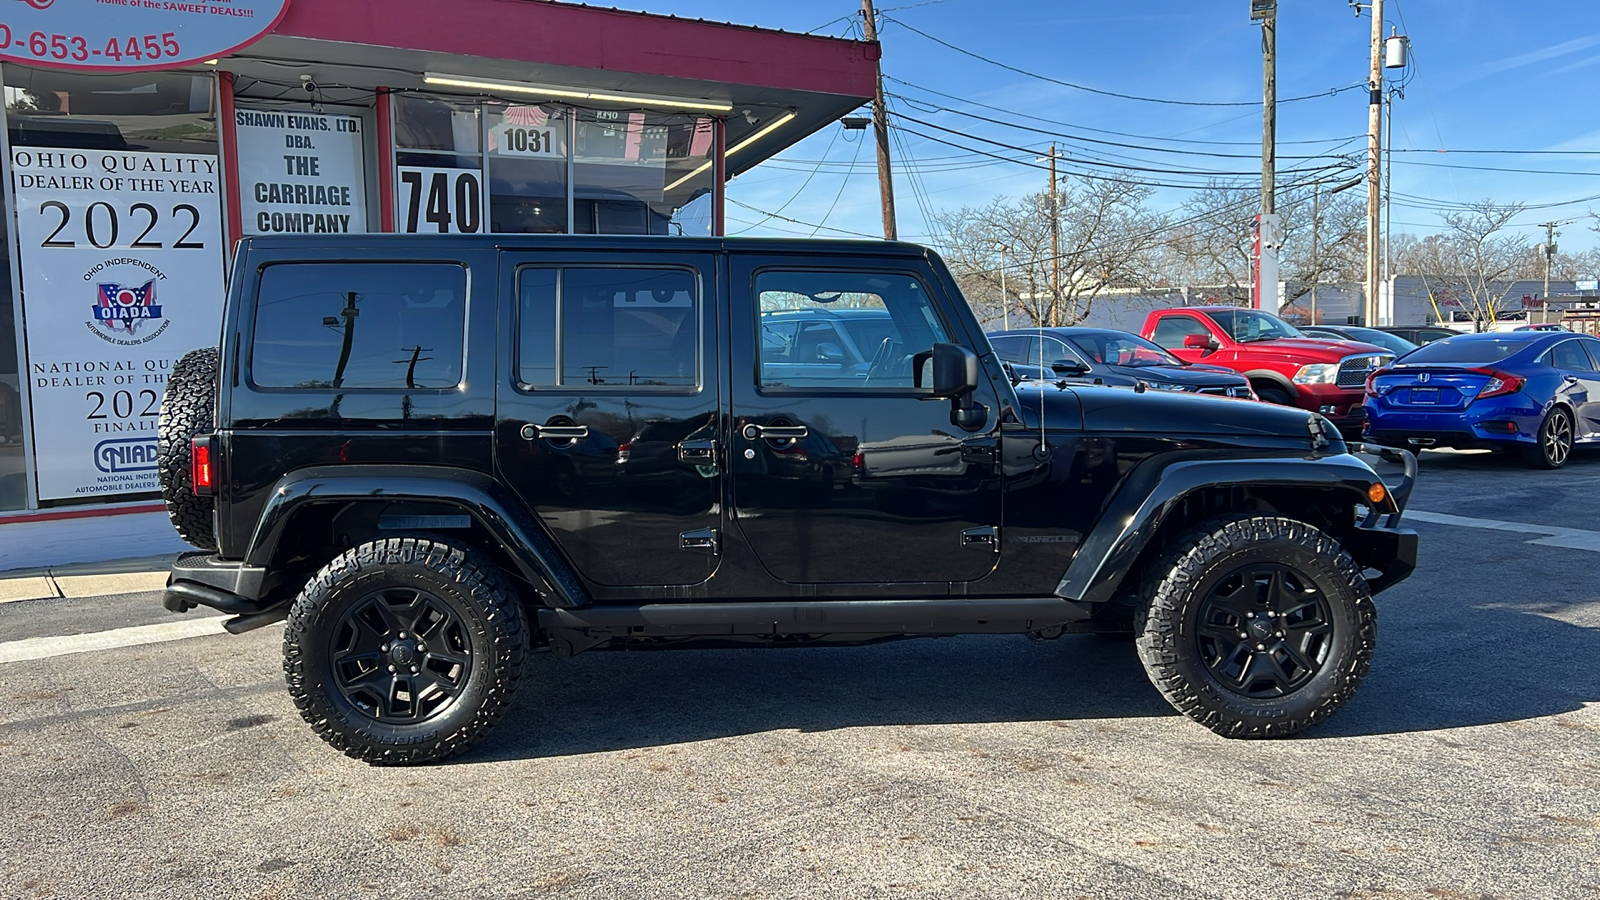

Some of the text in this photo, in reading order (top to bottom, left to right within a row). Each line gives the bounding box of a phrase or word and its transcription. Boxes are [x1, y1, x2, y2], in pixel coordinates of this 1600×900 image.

[143, 0, 161, 9] the
[163, 2, 208, 14] SAWEET
[210, 6, 254, 18] DEALS!!!
[0, 24, 180, 62] 0-653-4455
[236, 111, 360, 133] SHAWN EVANS. LTD.
[285, 134, 315, 149] DBA.
[504, 128, 551, 153] 1031
[15, 151, 216, 174] OHIO QUALITY
[283, 155, 320, 176] THE
[19, 174, 215, 194] DEALER OF THE YEAR
[254, 182, 351, 206] CARRIAGE
[402, 171, 481, 234] 740
[39, 200, 205, 249] 2022
[257, 211, 350, 233] COMPANY
[83, 257, 167, 281] OHIO INDEPENDENT
[101, 306, 151, 319] OIADA
[84, 321, 116, 344] AUTOMOBILE
[142, 318, 171, 344] ASSOCIATION
[33, 361, 136, 374] NATIONAL
[37, 376, 106, 388] DEALER
[114, 375, 135, 385] OF
[75, 484, 122, 493] AUTOMOBILE
[125, 481, 155, 490] DEALERS
[97, 474, 134, 483] NATIONAL
[1013, 534, 1080, 543] RANGLER
